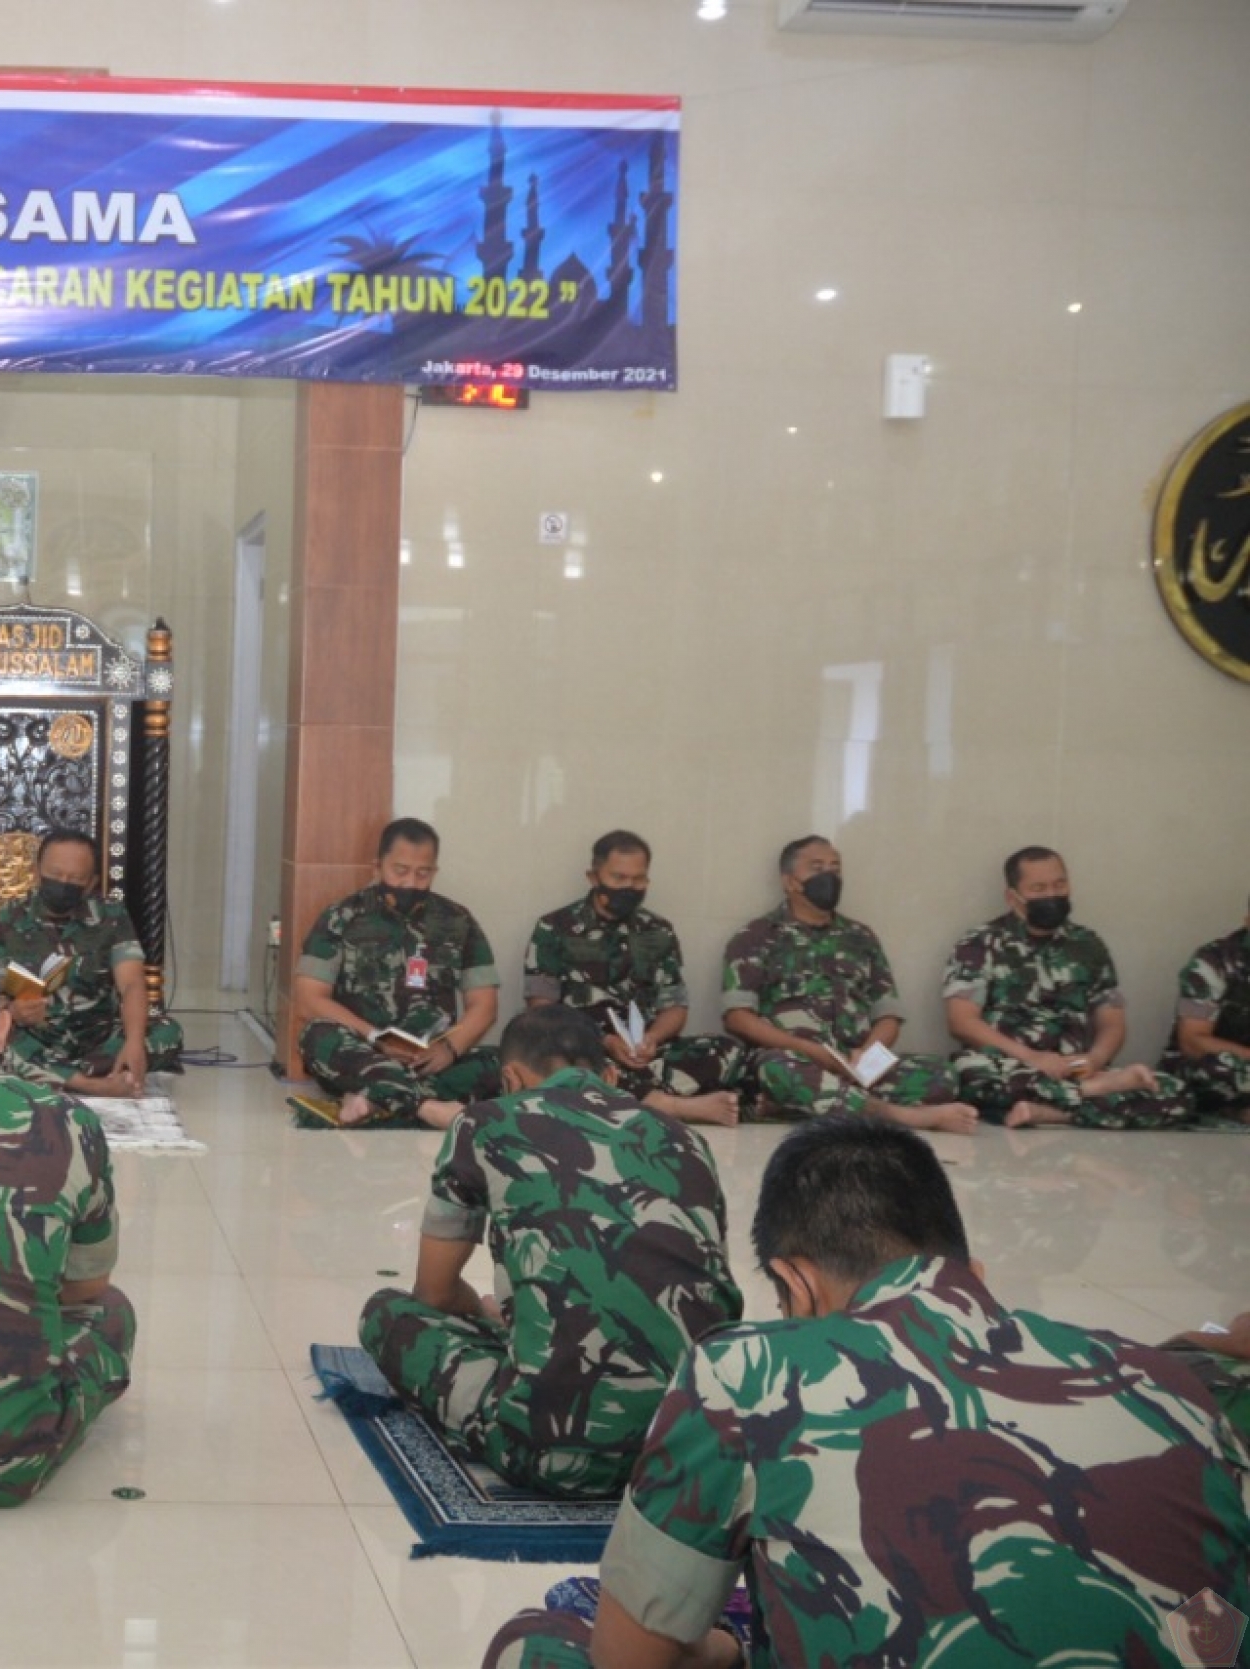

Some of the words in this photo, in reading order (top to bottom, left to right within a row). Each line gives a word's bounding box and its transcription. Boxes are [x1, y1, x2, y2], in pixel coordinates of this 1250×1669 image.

[125, 268, 316, 312] KEGIATAN
[326, 273, 455, 314] TAHUN
[463, 275, 550, 319] 2022
[421, 360, 498, 379] Jakarta,
[527, 364, 620, 382] Desember
[622, 366, 668, 383] 2021
